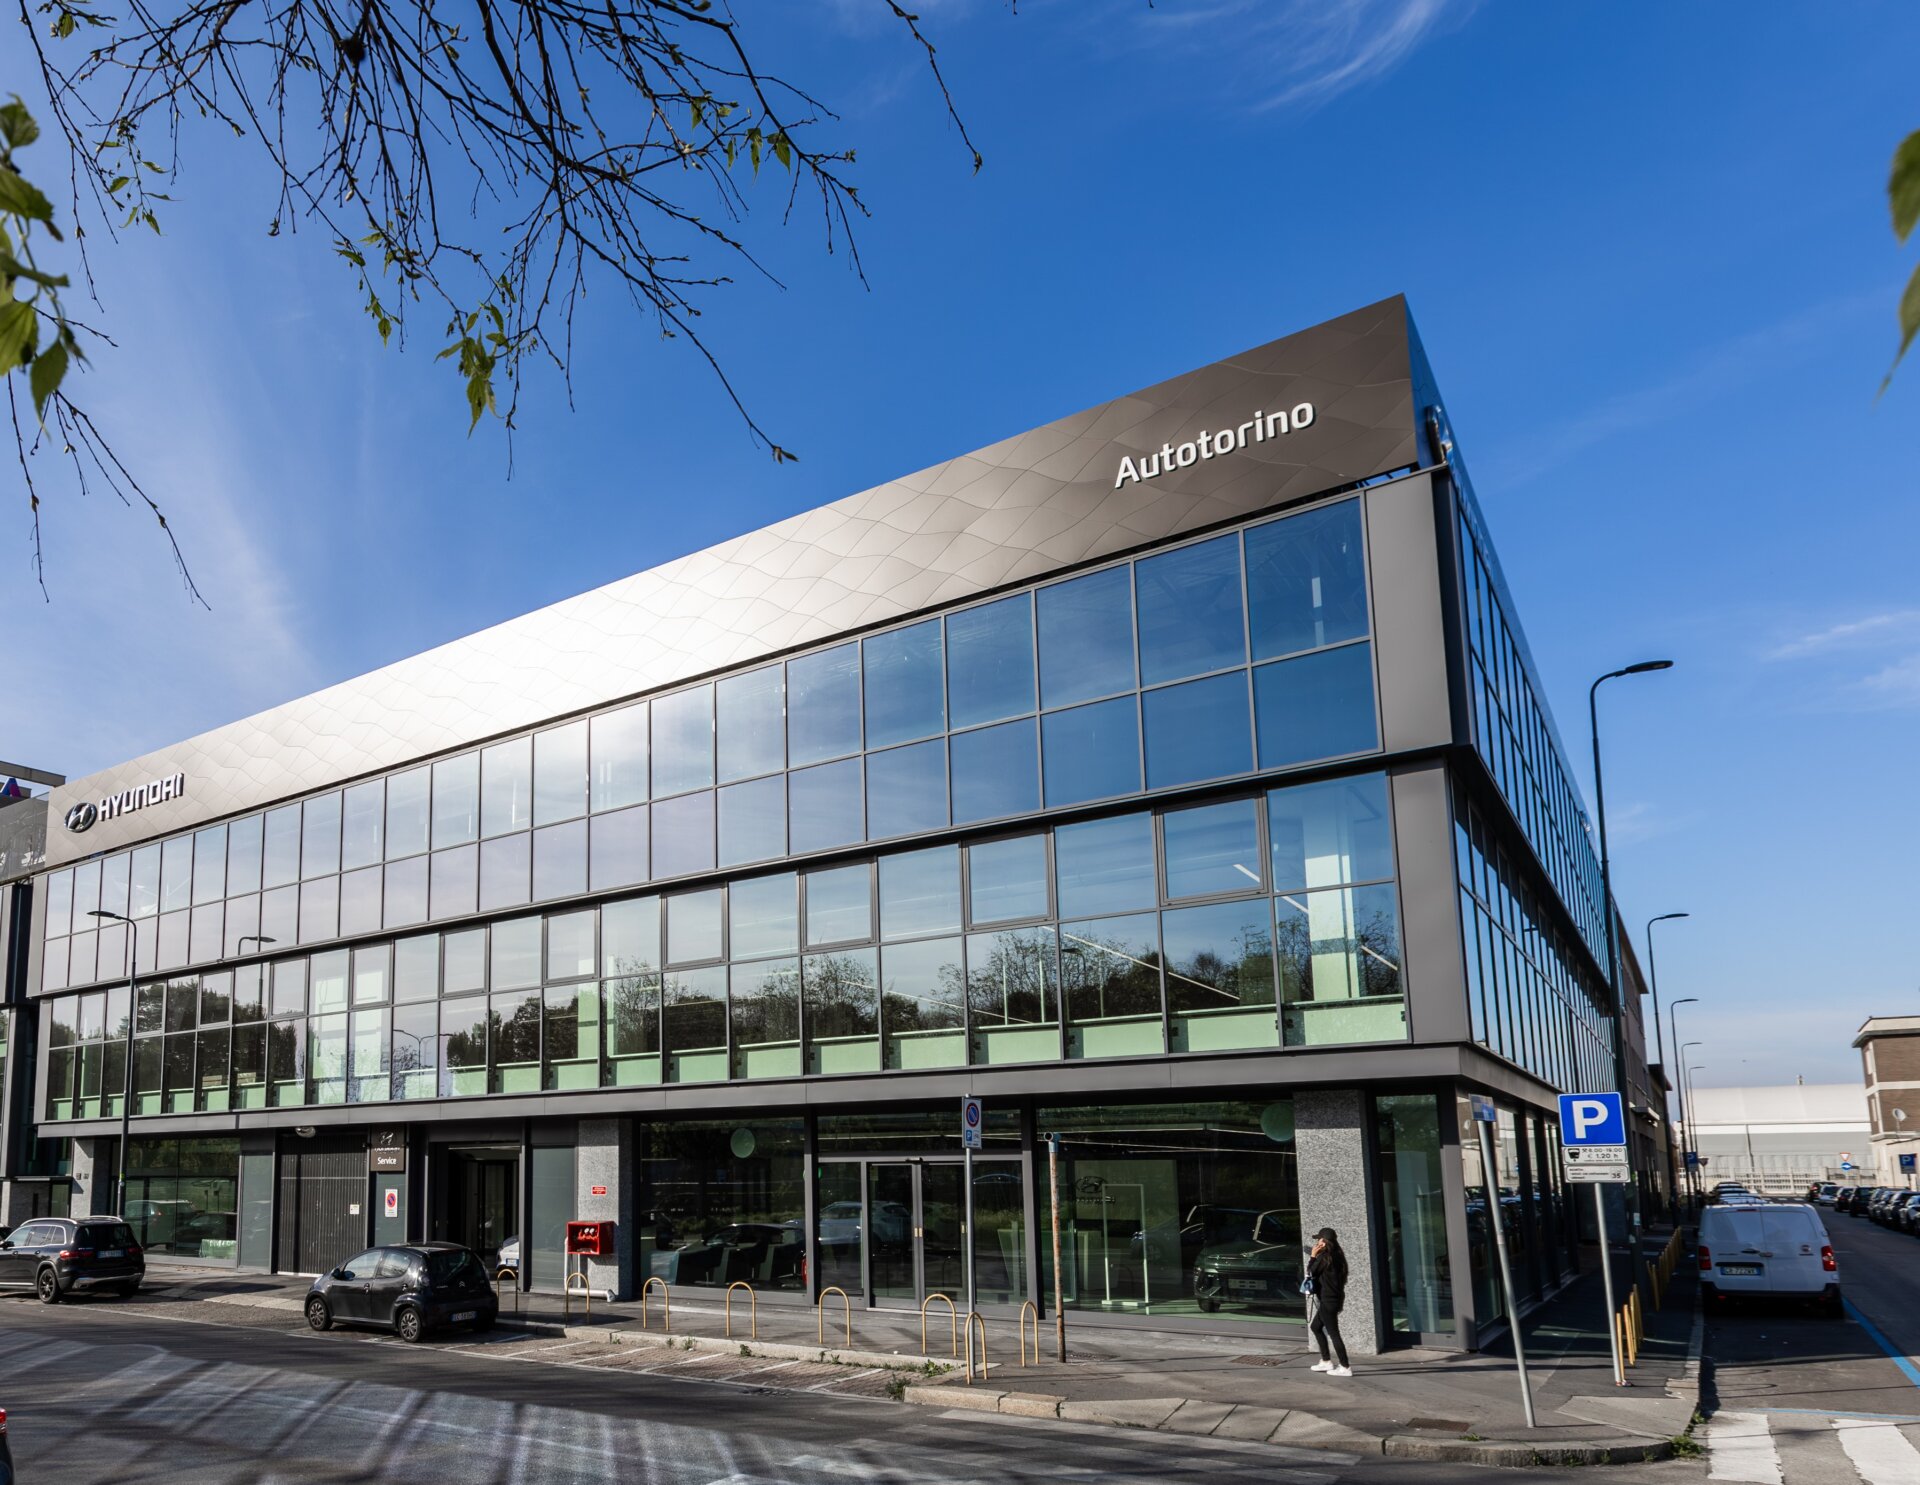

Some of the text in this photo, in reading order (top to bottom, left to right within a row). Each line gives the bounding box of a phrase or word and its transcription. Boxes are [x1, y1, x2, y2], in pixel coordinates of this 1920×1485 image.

[1115, 402, 1315, 488] Autotorino
[98, 773, 183, 821] HYUNDAI
[1572, 1100, 1609, 1139] P
